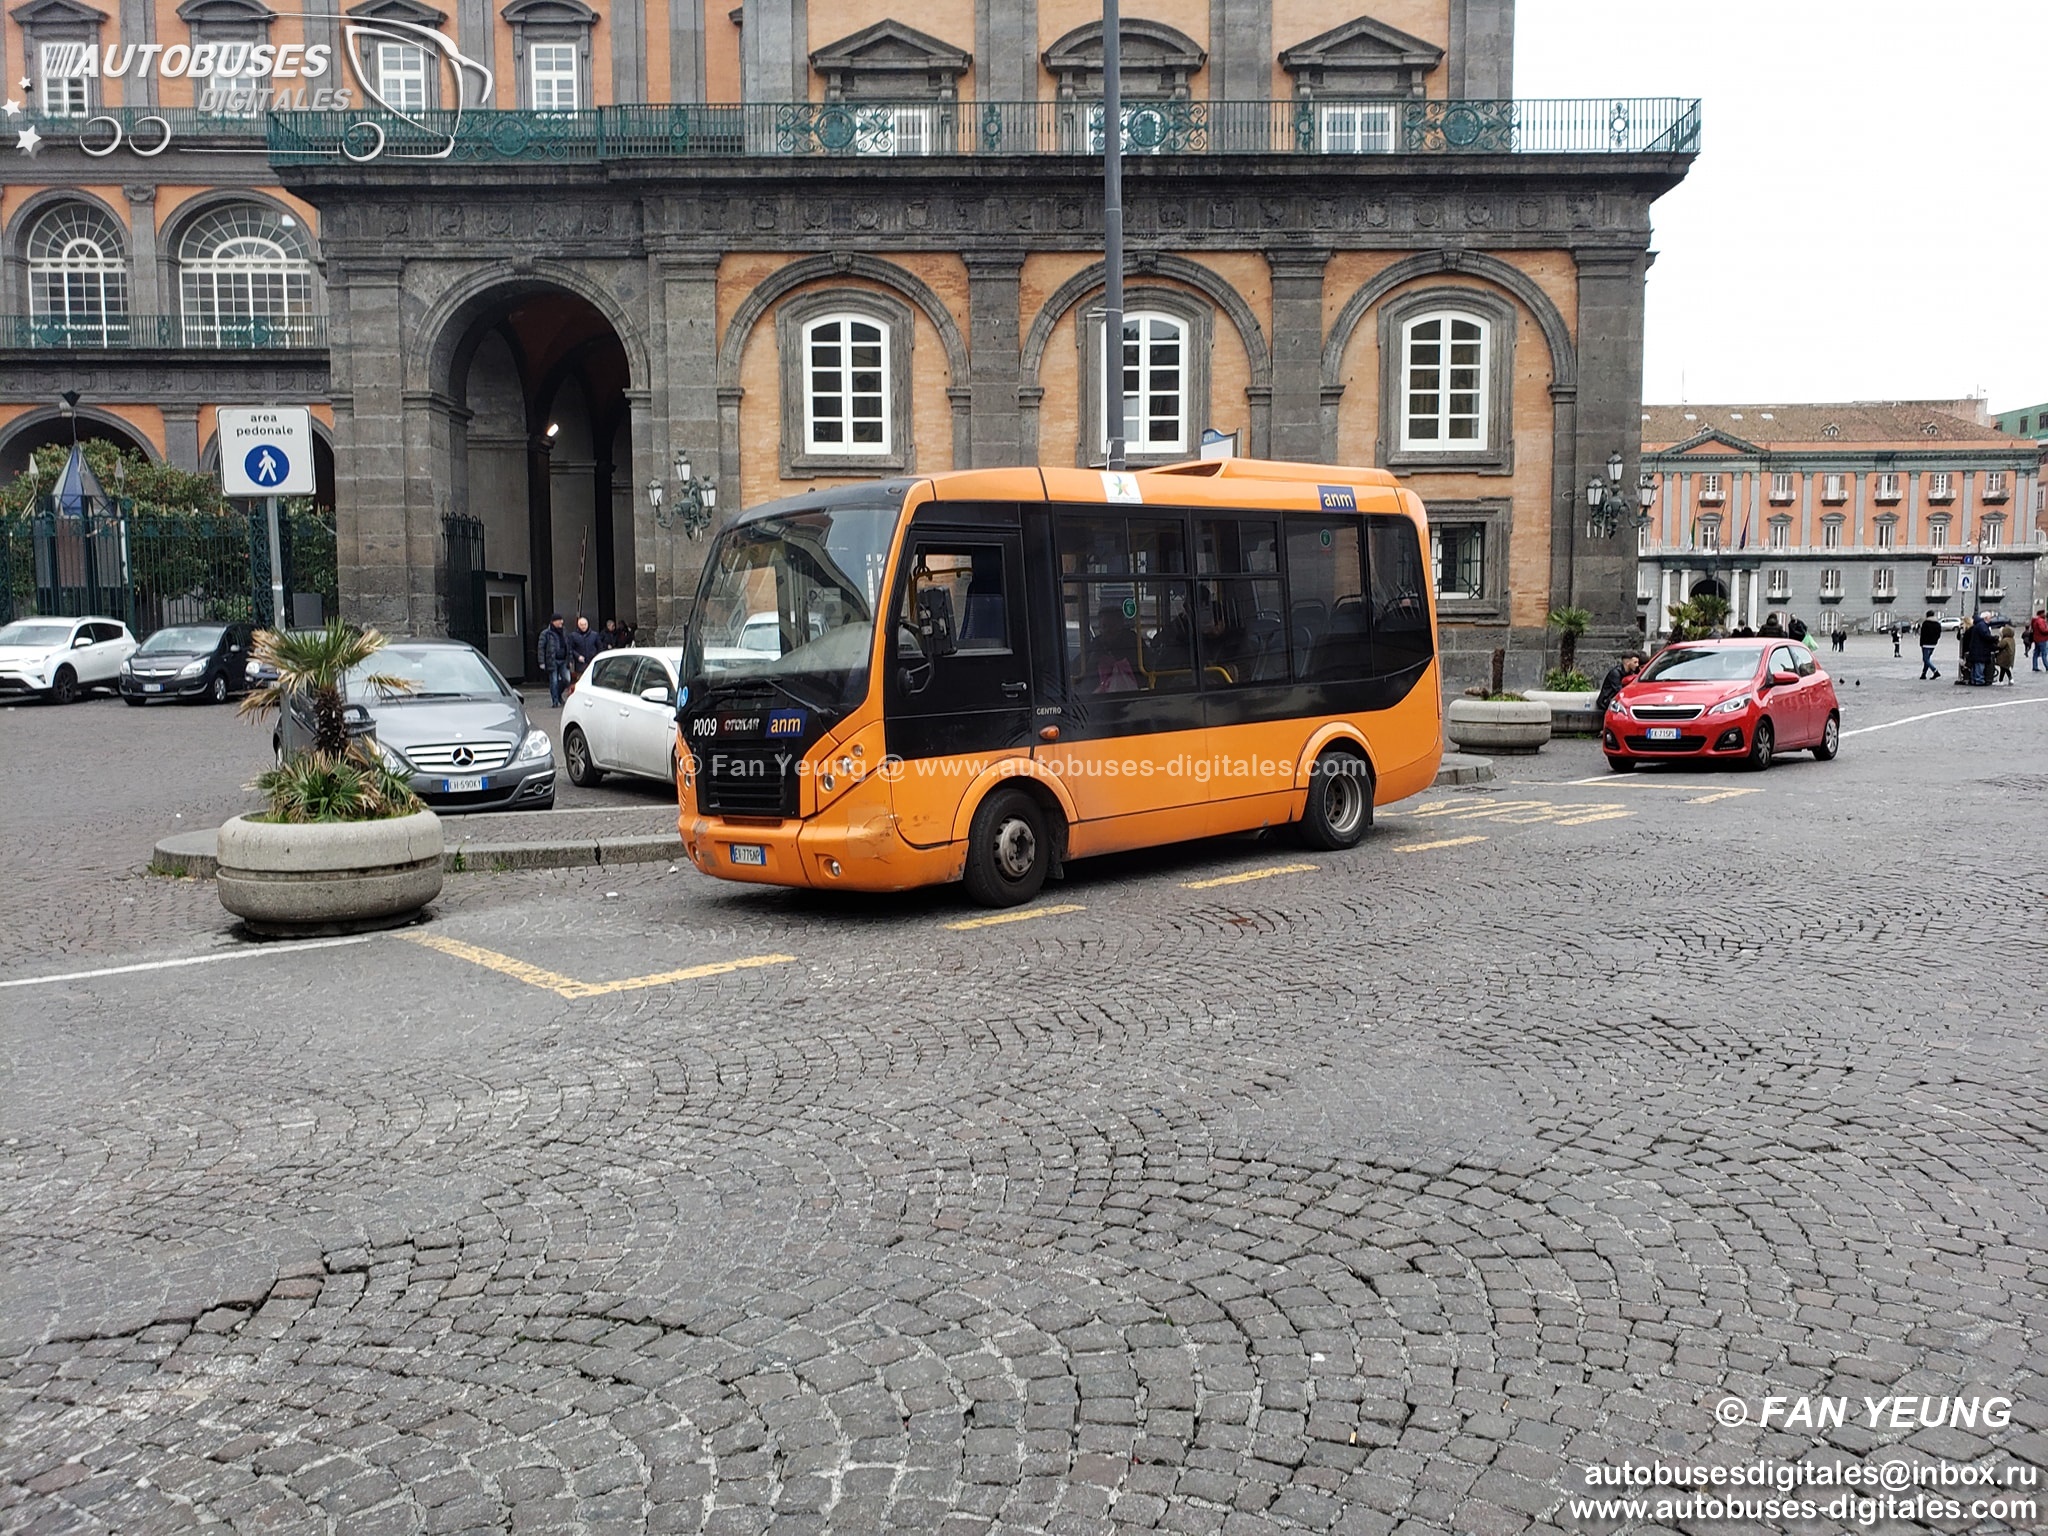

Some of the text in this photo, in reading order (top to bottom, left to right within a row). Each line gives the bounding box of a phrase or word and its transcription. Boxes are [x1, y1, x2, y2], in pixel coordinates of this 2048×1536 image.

[250, 414, 278, 423] area
[236, 425, 294, 437] pedonale
[1323, 493, 1354, 507] anm
[1036, 706, 1062, 716] CENTRO
[692, 717, 718, 737] P009
[770, 717, 801, 734] anm
